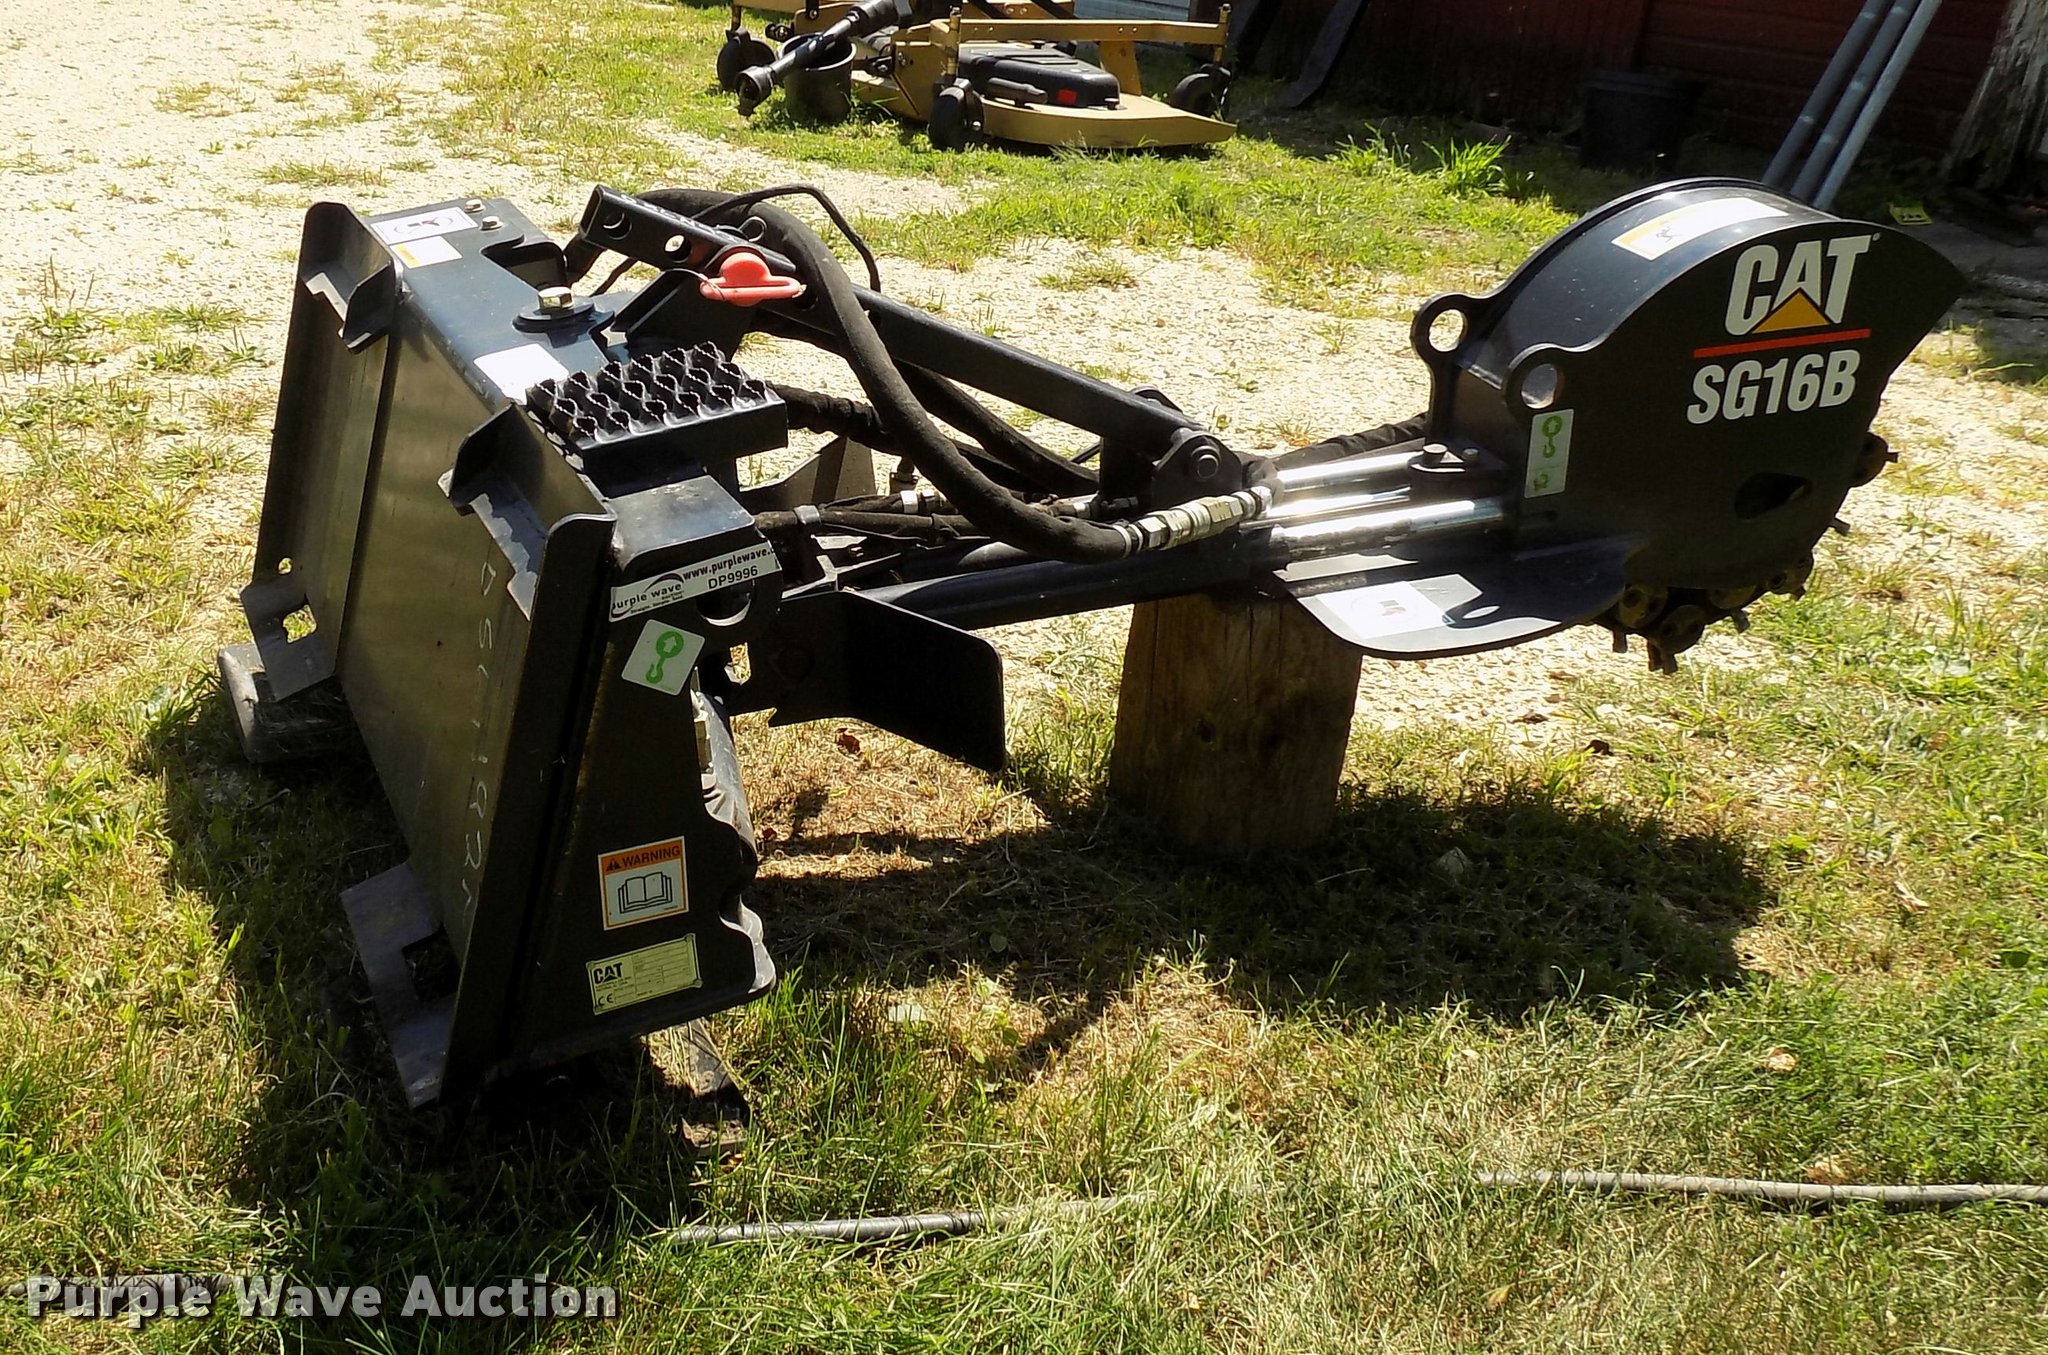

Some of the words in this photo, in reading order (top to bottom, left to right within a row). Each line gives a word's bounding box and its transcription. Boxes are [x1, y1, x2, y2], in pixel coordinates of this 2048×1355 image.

[1725, 235, 1872, 335] CAT
[1687, 349, 1860, 424] SG16B
[708, 565, 758, 589] DP9996
[651, 583, 681, 598] wave
[622, 845, 680, 868] WARNING
[593, 962, 622, 984] CAT
